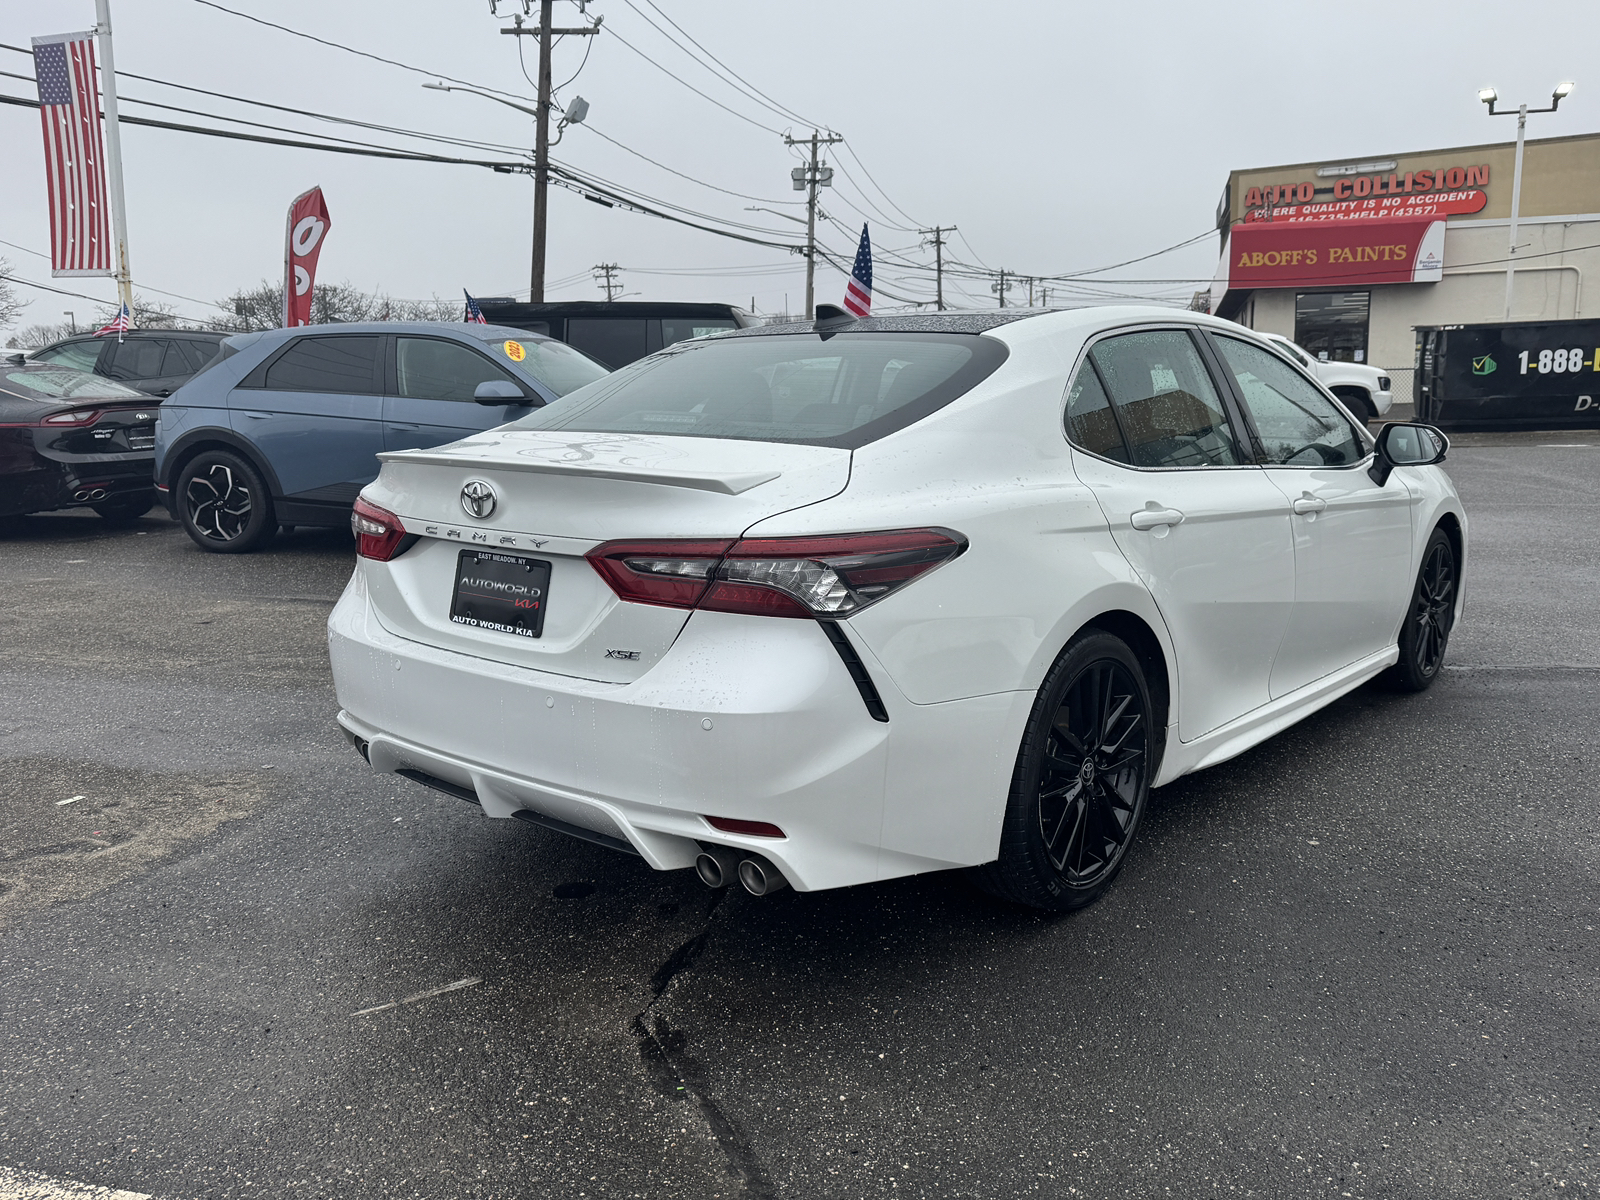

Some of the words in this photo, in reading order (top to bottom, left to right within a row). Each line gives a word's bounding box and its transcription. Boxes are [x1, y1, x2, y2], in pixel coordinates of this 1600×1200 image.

[1245, 182, 1314, 207] AUTO
[1334, 164, 1489, 199] COLLISION
[1302, 201, 1358, 214] QUALITY
[1362, 199, 1377, 209] IS
[1382, 197, 1402, 207] NO
[1407, 191, 1477, 205] ACCIDENT
[1237, 249, 1318, 267] ABOFF'S
[1328, 244, 1407, 264] PAINTS
[425, 525, 549, 548] CAMRY
[478, 552, 492, 561] EAST
[517, 558, 527, 566] NY
[460, 576, 541, 598] AUTOWORLD
[515, 598, 540, 610] KIA
[452, 615, 477, 626] AUTO
[479, 620, 514, 633] WORLD
[515, 627, 533, 637] KIA
[604, 649, 641, 661] XSE
